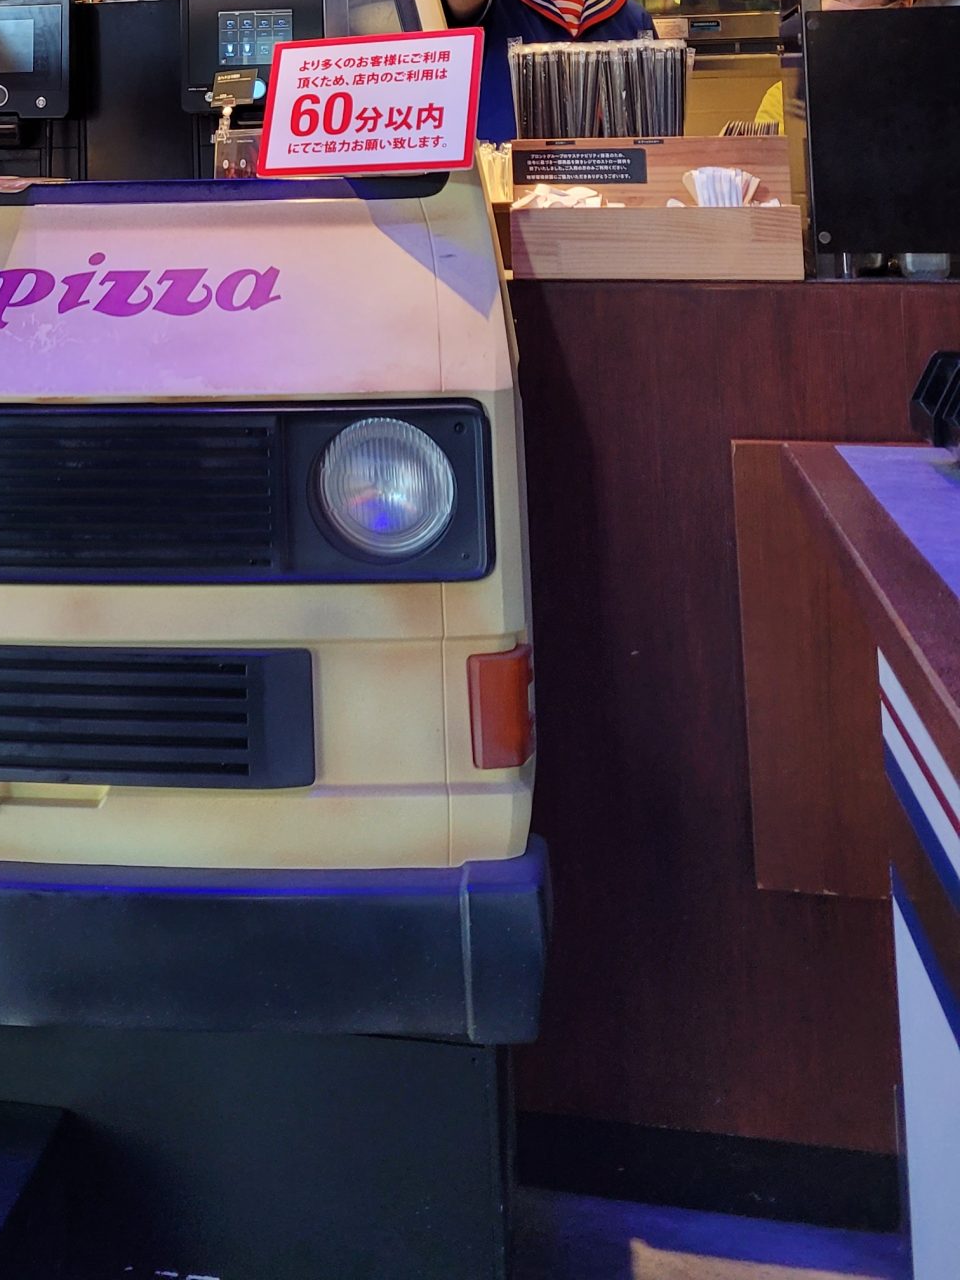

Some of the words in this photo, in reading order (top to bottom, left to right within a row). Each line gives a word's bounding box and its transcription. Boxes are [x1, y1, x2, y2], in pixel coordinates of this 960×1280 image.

[298, 51, 451, 71] より多くのお客様にご利用
[296, 68, 448, 88] 頂くため、店内のご利用は
[289, 91, 445, 137] 60分以内
[288, 135, 448, 154] にてご協力お願い致します。
